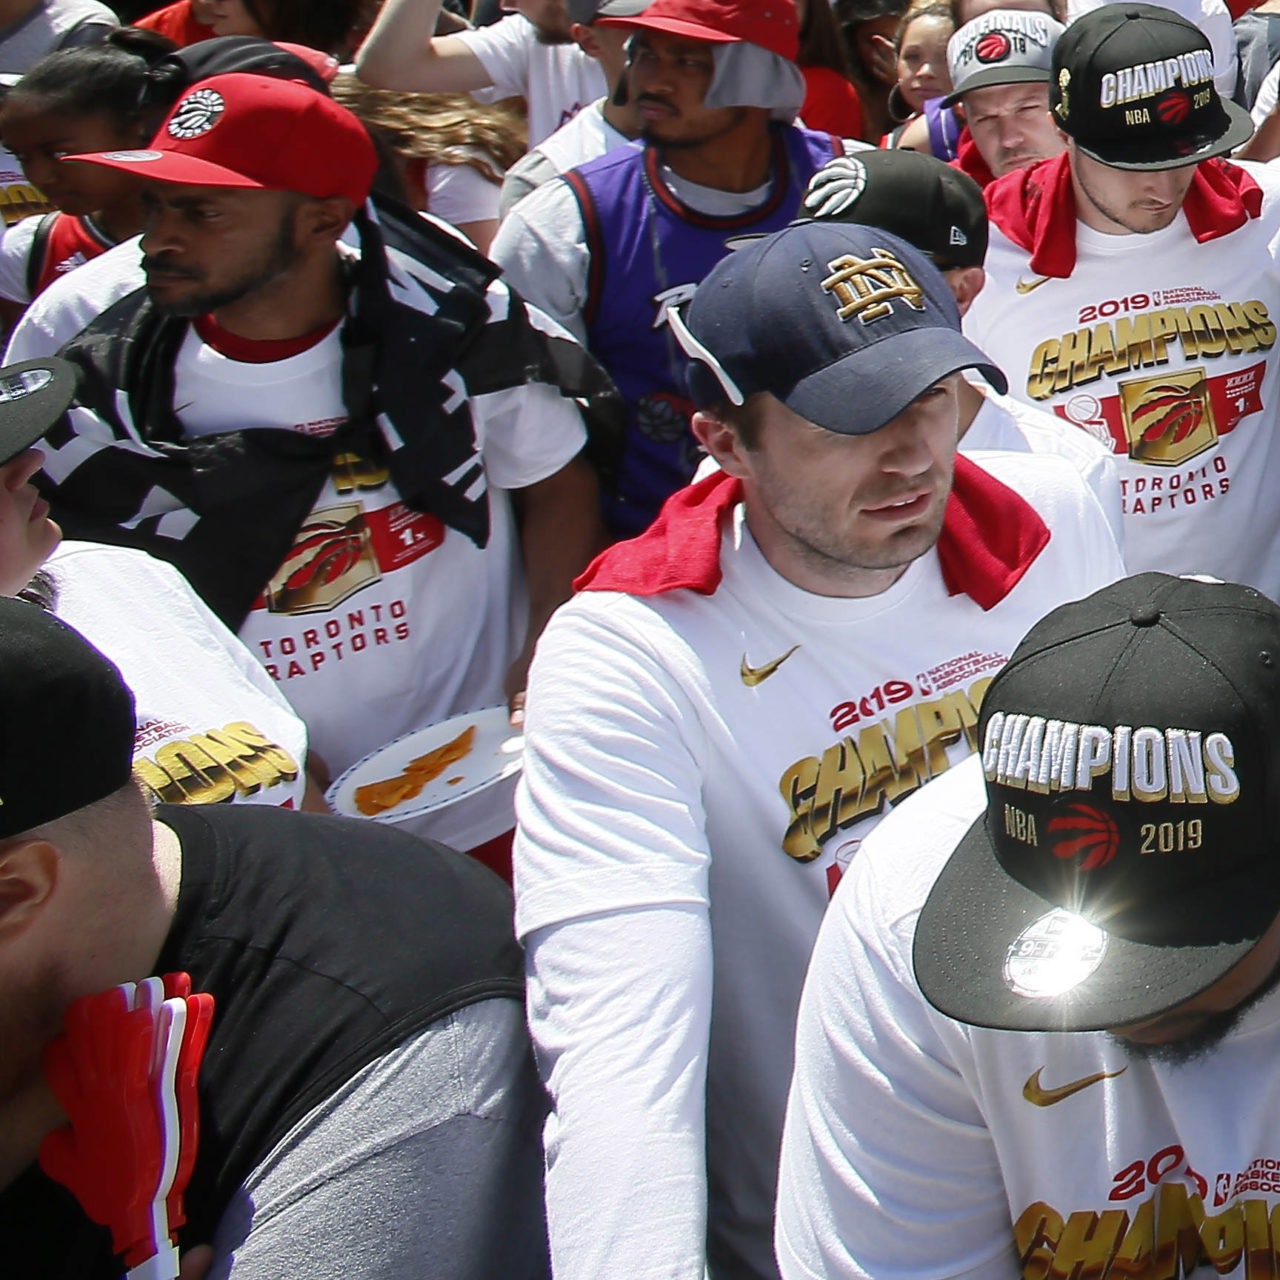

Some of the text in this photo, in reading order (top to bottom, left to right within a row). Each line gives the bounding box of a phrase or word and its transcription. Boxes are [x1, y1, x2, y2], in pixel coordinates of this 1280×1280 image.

[1125, 107, 1150, 126] NBA
[1162, 286, 1204, 295] NATIONAL
[1163, 290, 1218, 301] BASKETBALL
[1163, 295, 1222, 305] ASSOCIATION
[1079, 293, 1150, 324] 2019
[1026, 300, 1278, 402] CHAMPIONS
[927, 650, 984, 676] NATIONAL
[930, 651, 1003, 684] BASKETBALL
[982, 710, 1240, 805] CHAMPIONS
[1003, 803, 1203, 855] NBA 2019
